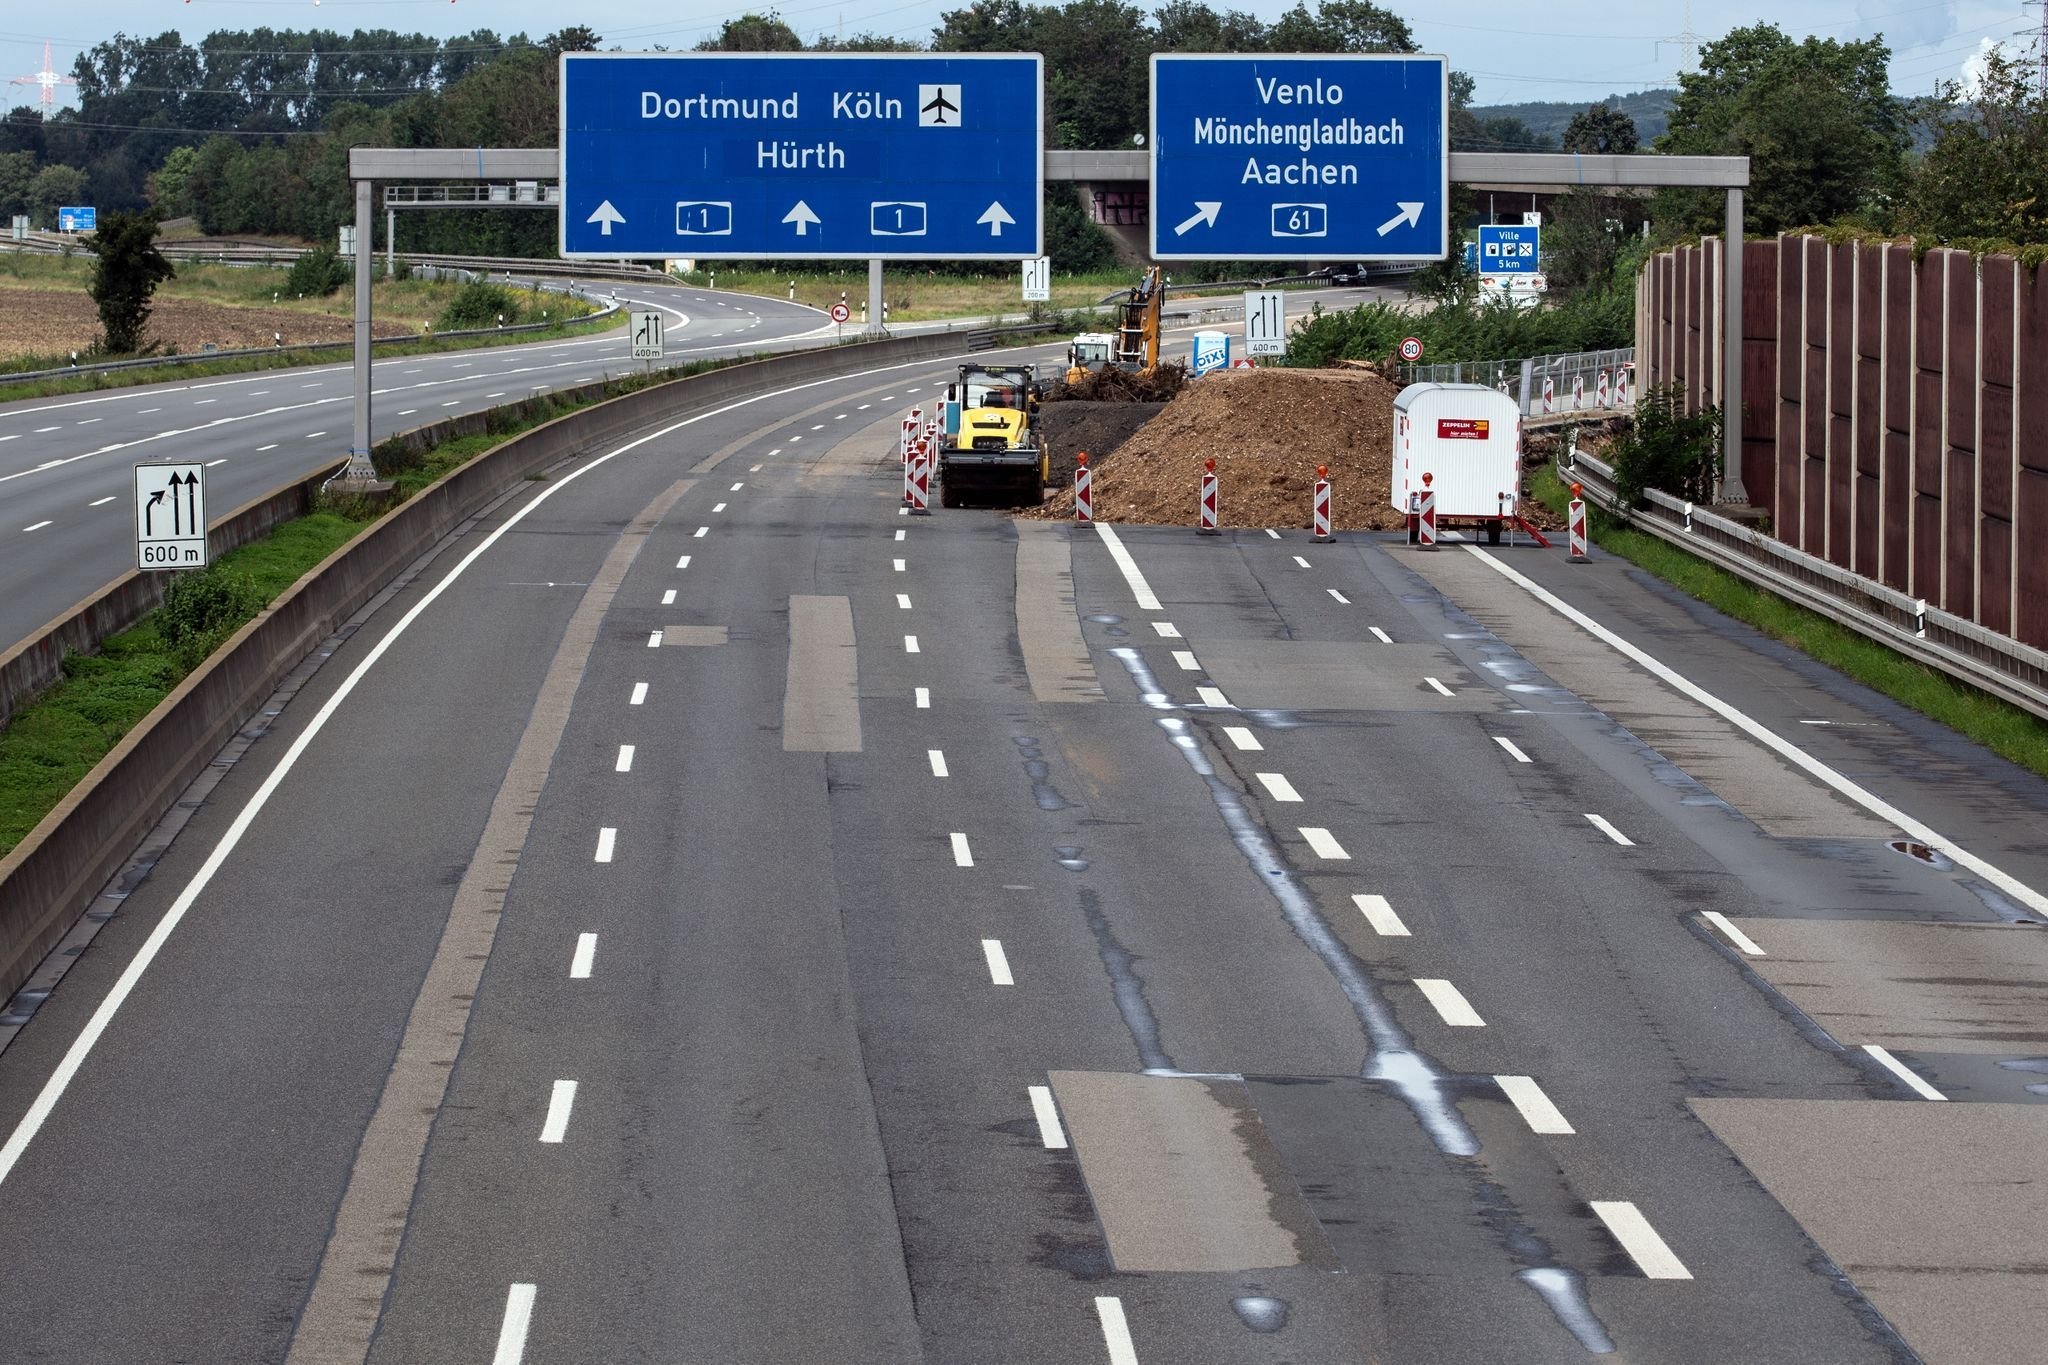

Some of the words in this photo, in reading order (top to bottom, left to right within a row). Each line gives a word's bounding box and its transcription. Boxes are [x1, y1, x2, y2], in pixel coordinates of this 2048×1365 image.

[1256, 77, 1343, 105] Venlo
[641, 92, 798, 119] Dortmund
[833, 92, 902, 119] Köln
[1195, 117, 1404, 152] Mönchengladbach
[757, 141, 845, 169] Hürth
[1241, 158, 1358, 185] Aachen
[700, 208, 708, 228] 1
[894, 208, 902, 228] 1
[1288, 210, 1310, 230] 61
[1499, 231, 1520, 240] Ville
[1498, 259, 1504, 268] 5
[1505, 259, 1520, 268] km
[1252, 343, 1268, 352] 400
[1270, 344, 1279, 352] m
[1404, 343, 1418, 355] 80
[144, 545, 178, 563] 600
[184, 549, 199, 562] m
